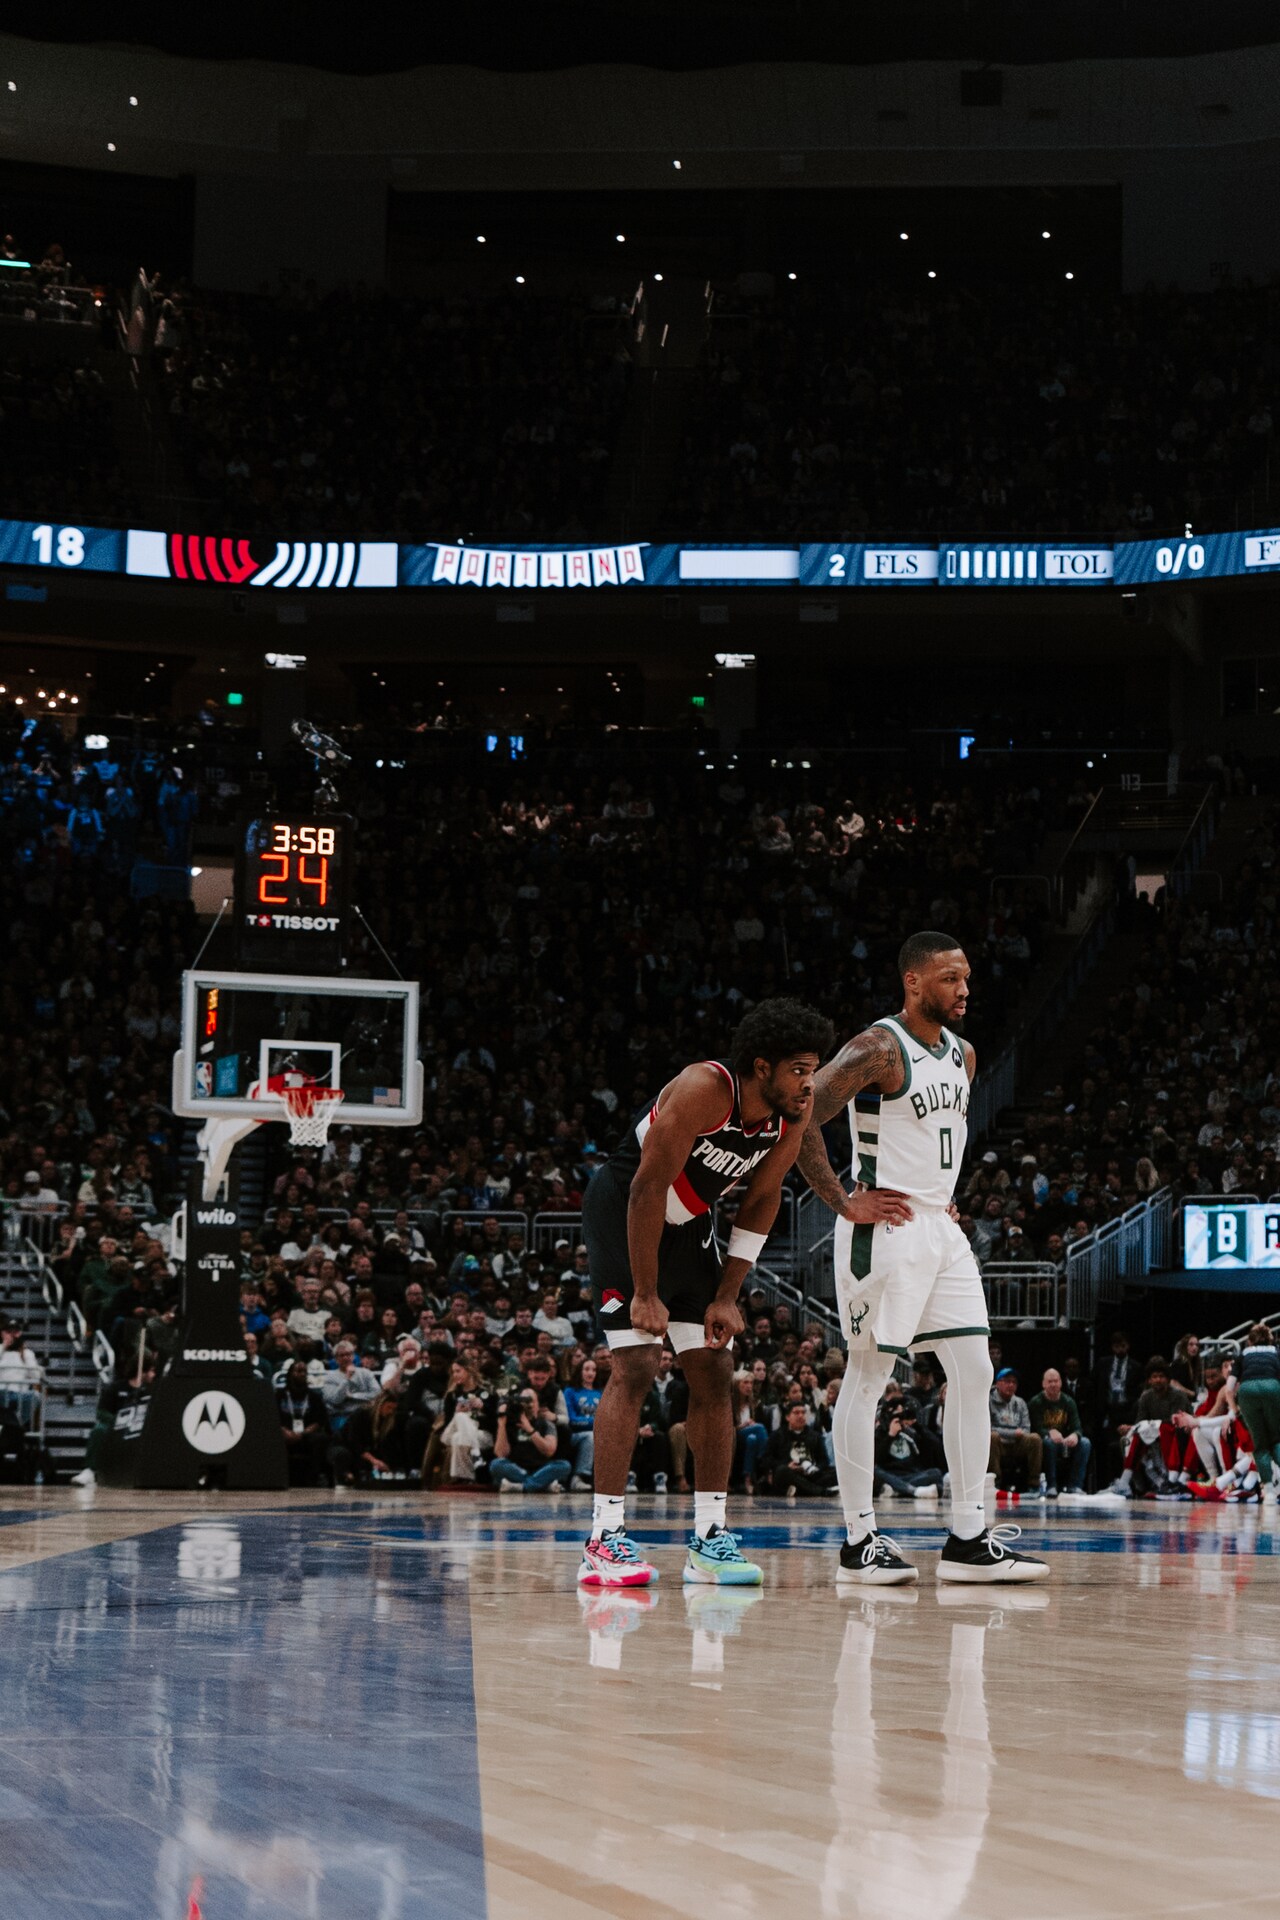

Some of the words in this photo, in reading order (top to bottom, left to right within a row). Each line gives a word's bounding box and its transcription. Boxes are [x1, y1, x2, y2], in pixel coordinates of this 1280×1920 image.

[32, 525, 85, 565] 18
[1156, 543, 1205, 575] 0/0
[441, 549, 638, 579] PORTLAND
[829, 554, 846, 577] 2
[874, 554, 919, 575] FLS
[1053, 554, 1107, 575] TOL
[272, 824, 335, 855] 3:58
[258, 853, 328, 907] 24
[272, 914, 340, 931] TISSOT
[940, 1128, 952, 1169] 0
[197, 1208, 236, 1225] wilo
[198, 1259, 236, 1270] ULTRA
